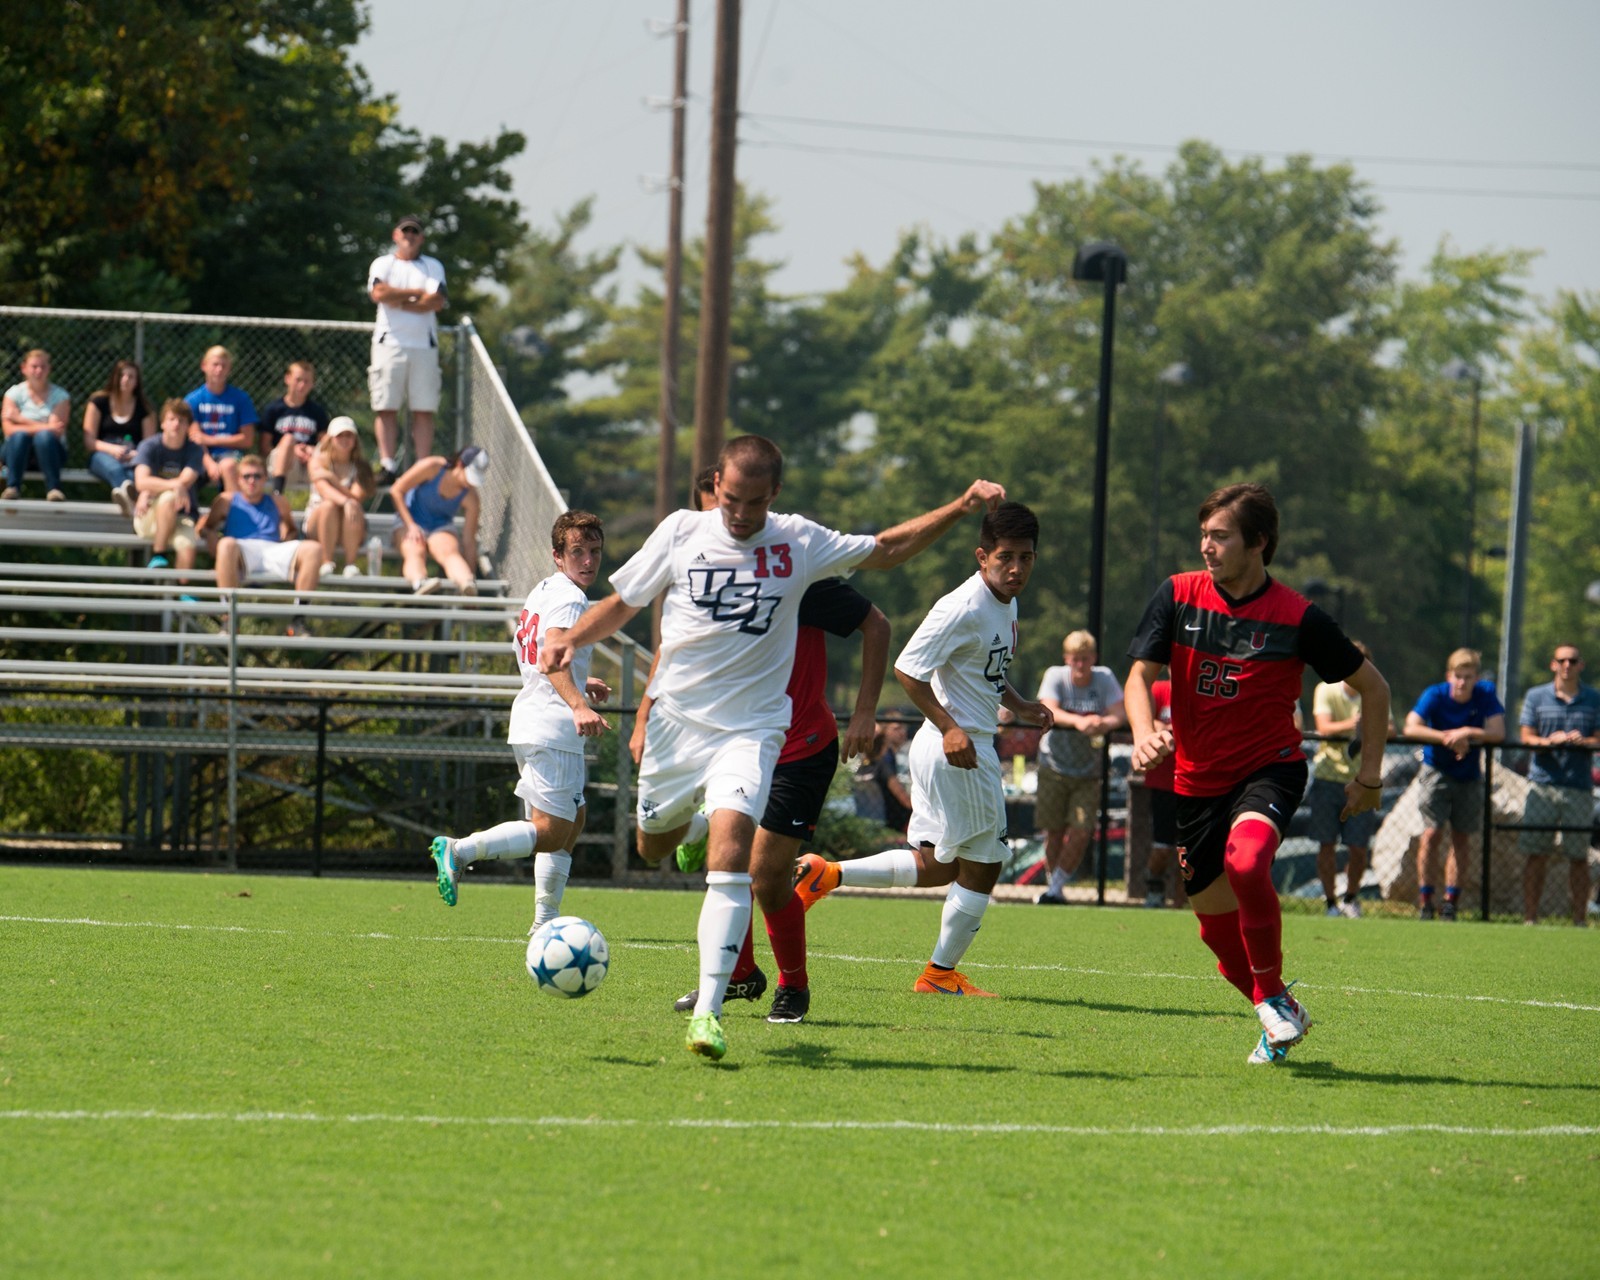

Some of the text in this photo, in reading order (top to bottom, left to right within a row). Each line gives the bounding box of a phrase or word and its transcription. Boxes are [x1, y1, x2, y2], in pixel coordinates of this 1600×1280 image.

[753, 543, 793, 578] 13
[688, 568, 782, 636] USI
[1196, 659, 1243, 699] 25
[724, 982, 757, 997] CR7
